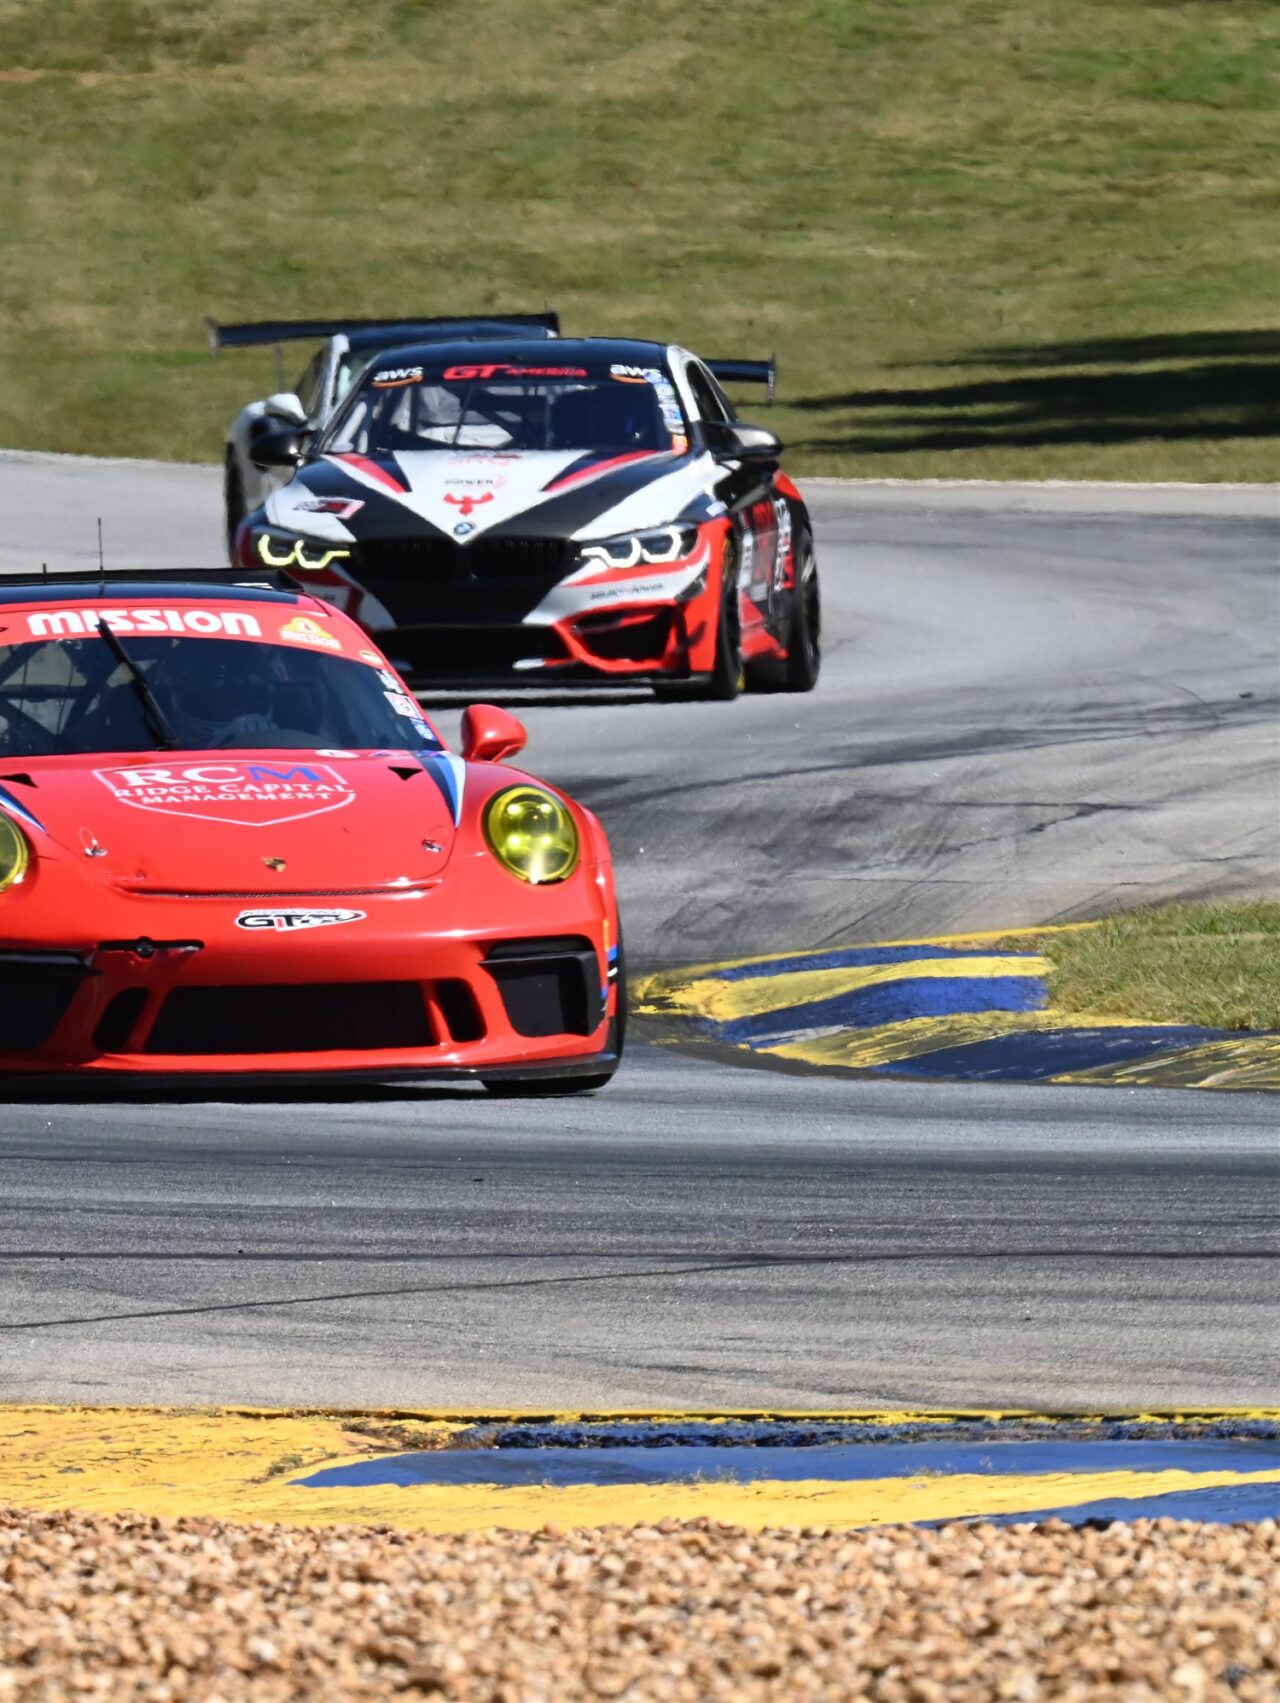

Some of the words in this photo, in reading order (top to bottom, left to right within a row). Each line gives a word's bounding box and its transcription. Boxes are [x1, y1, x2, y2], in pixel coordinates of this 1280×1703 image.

[373, 366, 424, 381] aws
[443, 364, 512, 380] GT
[114, 766, 325, 787] RCM
[114, 785, 212, 798] RIDGE
[223, 782, 355, 793] CAPITAL
[142, 792, 332, 804] MANAGEMENT
